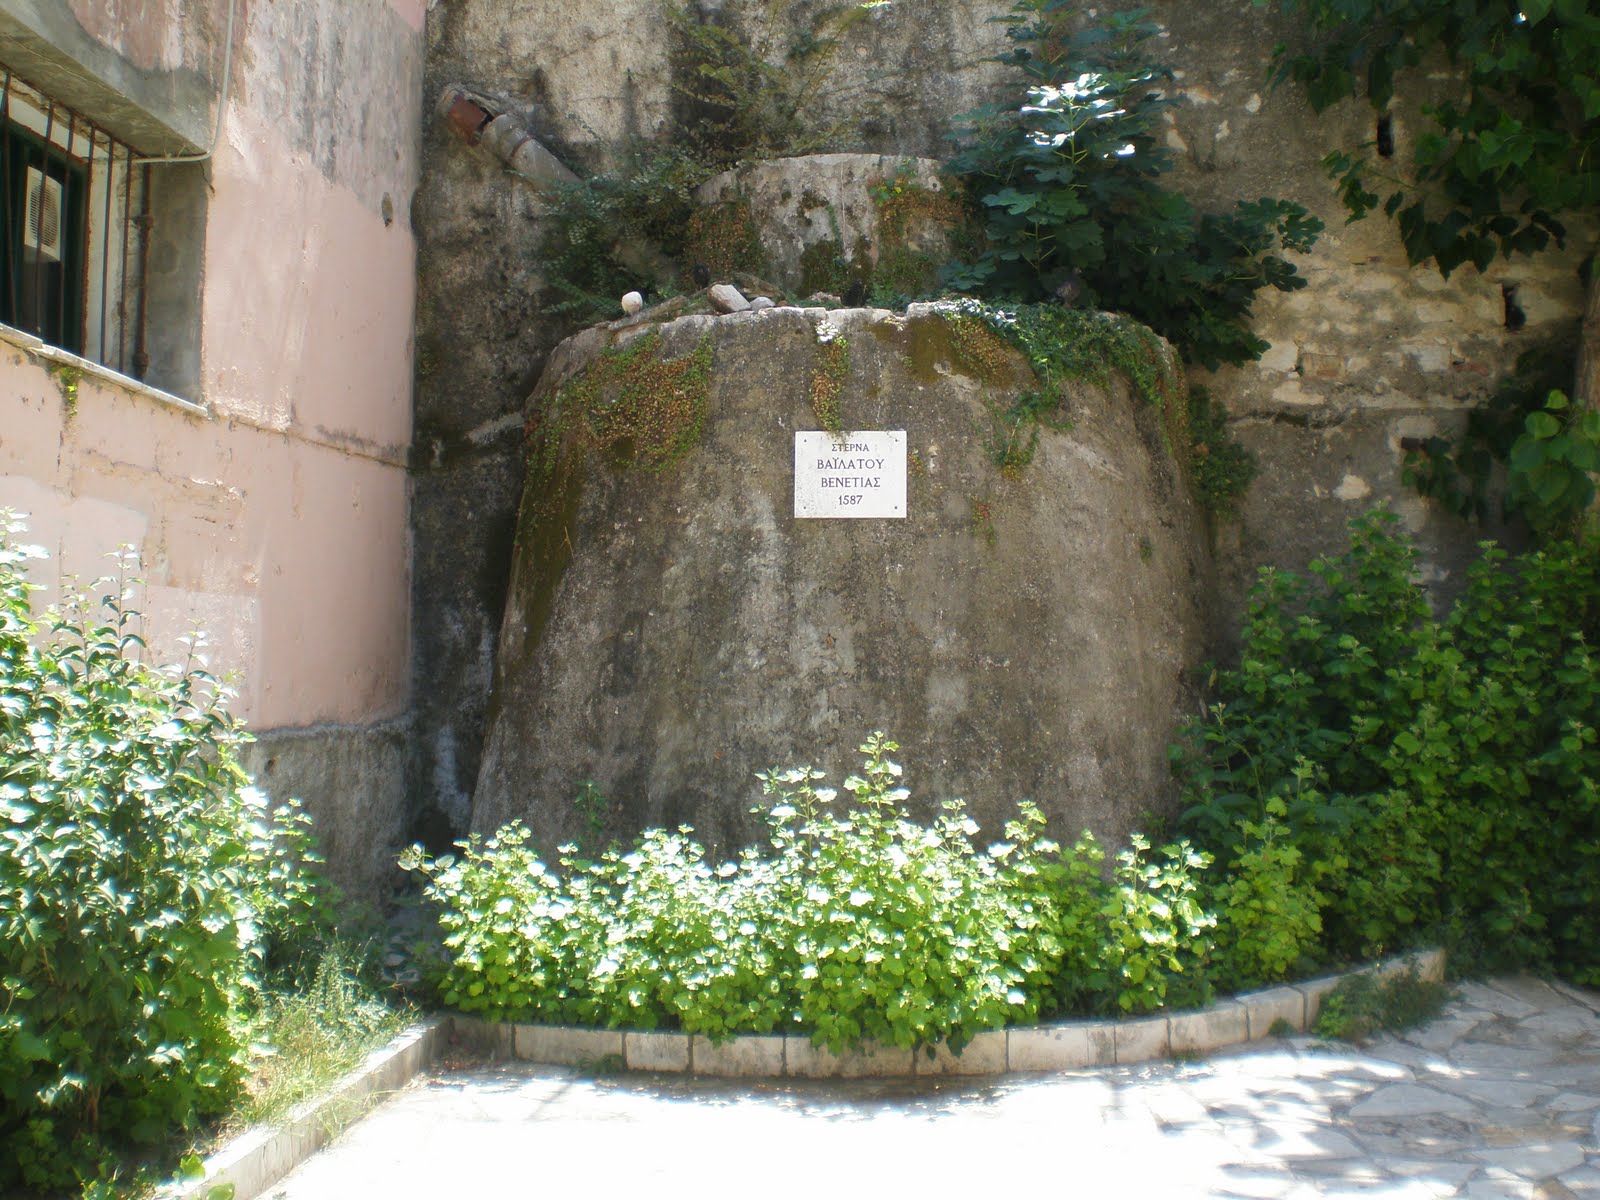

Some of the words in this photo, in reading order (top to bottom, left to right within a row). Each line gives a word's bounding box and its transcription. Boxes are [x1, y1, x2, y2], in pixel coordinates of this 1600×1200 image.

[831, 443, 870, 452] ΣΤΕΡΝΑ
[820, 477, 881, 488] ΒΕΝΕΤΙΑΣ
[838, 495, 863, 505] 1587
